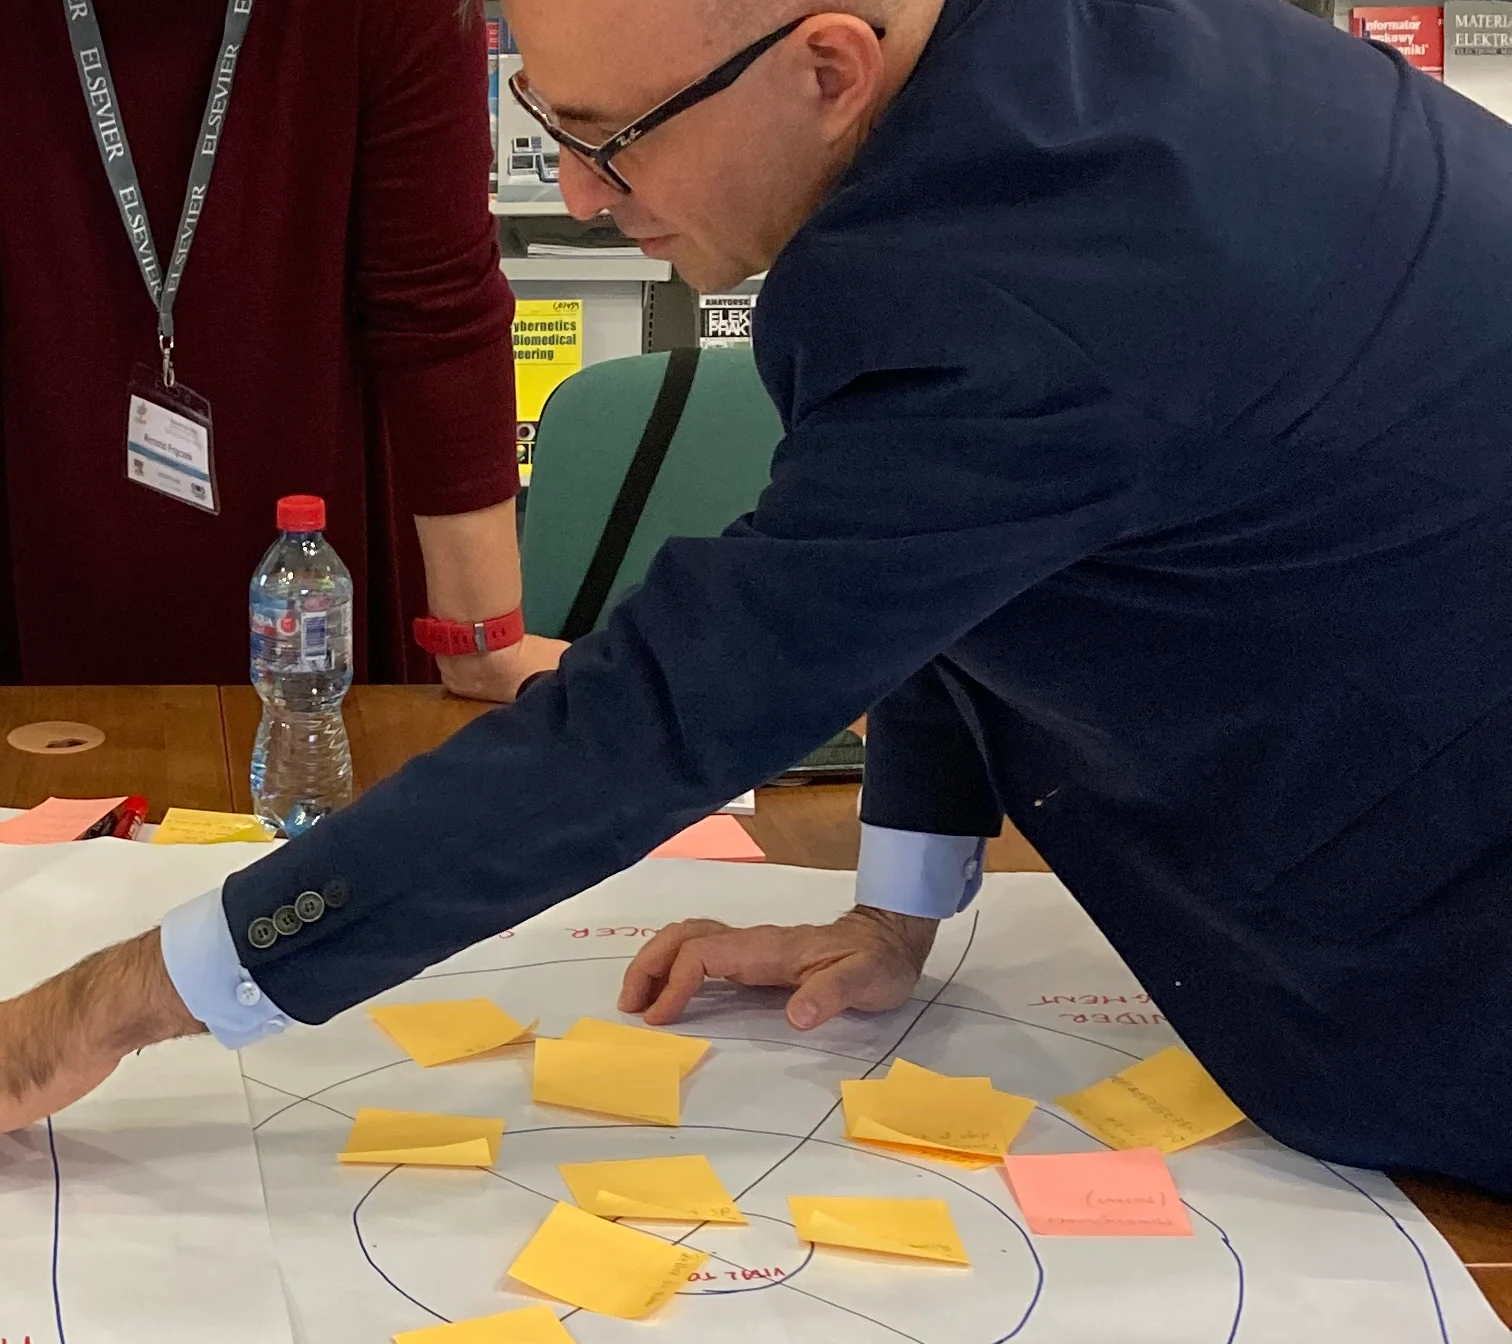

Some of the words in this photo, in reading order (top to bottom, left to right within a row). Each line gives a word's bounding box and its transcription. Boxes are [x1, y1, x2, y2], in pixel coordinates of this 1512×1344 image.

[79, 46, 125, 163] ELSEVIER
[201, 43, 240, 156] ELSEVIER
[118, 184, 164, 298] ELSEVIER
[167, 183, 207, 293] ELSEVIER
[688, 1271, 717, 1282] TO
